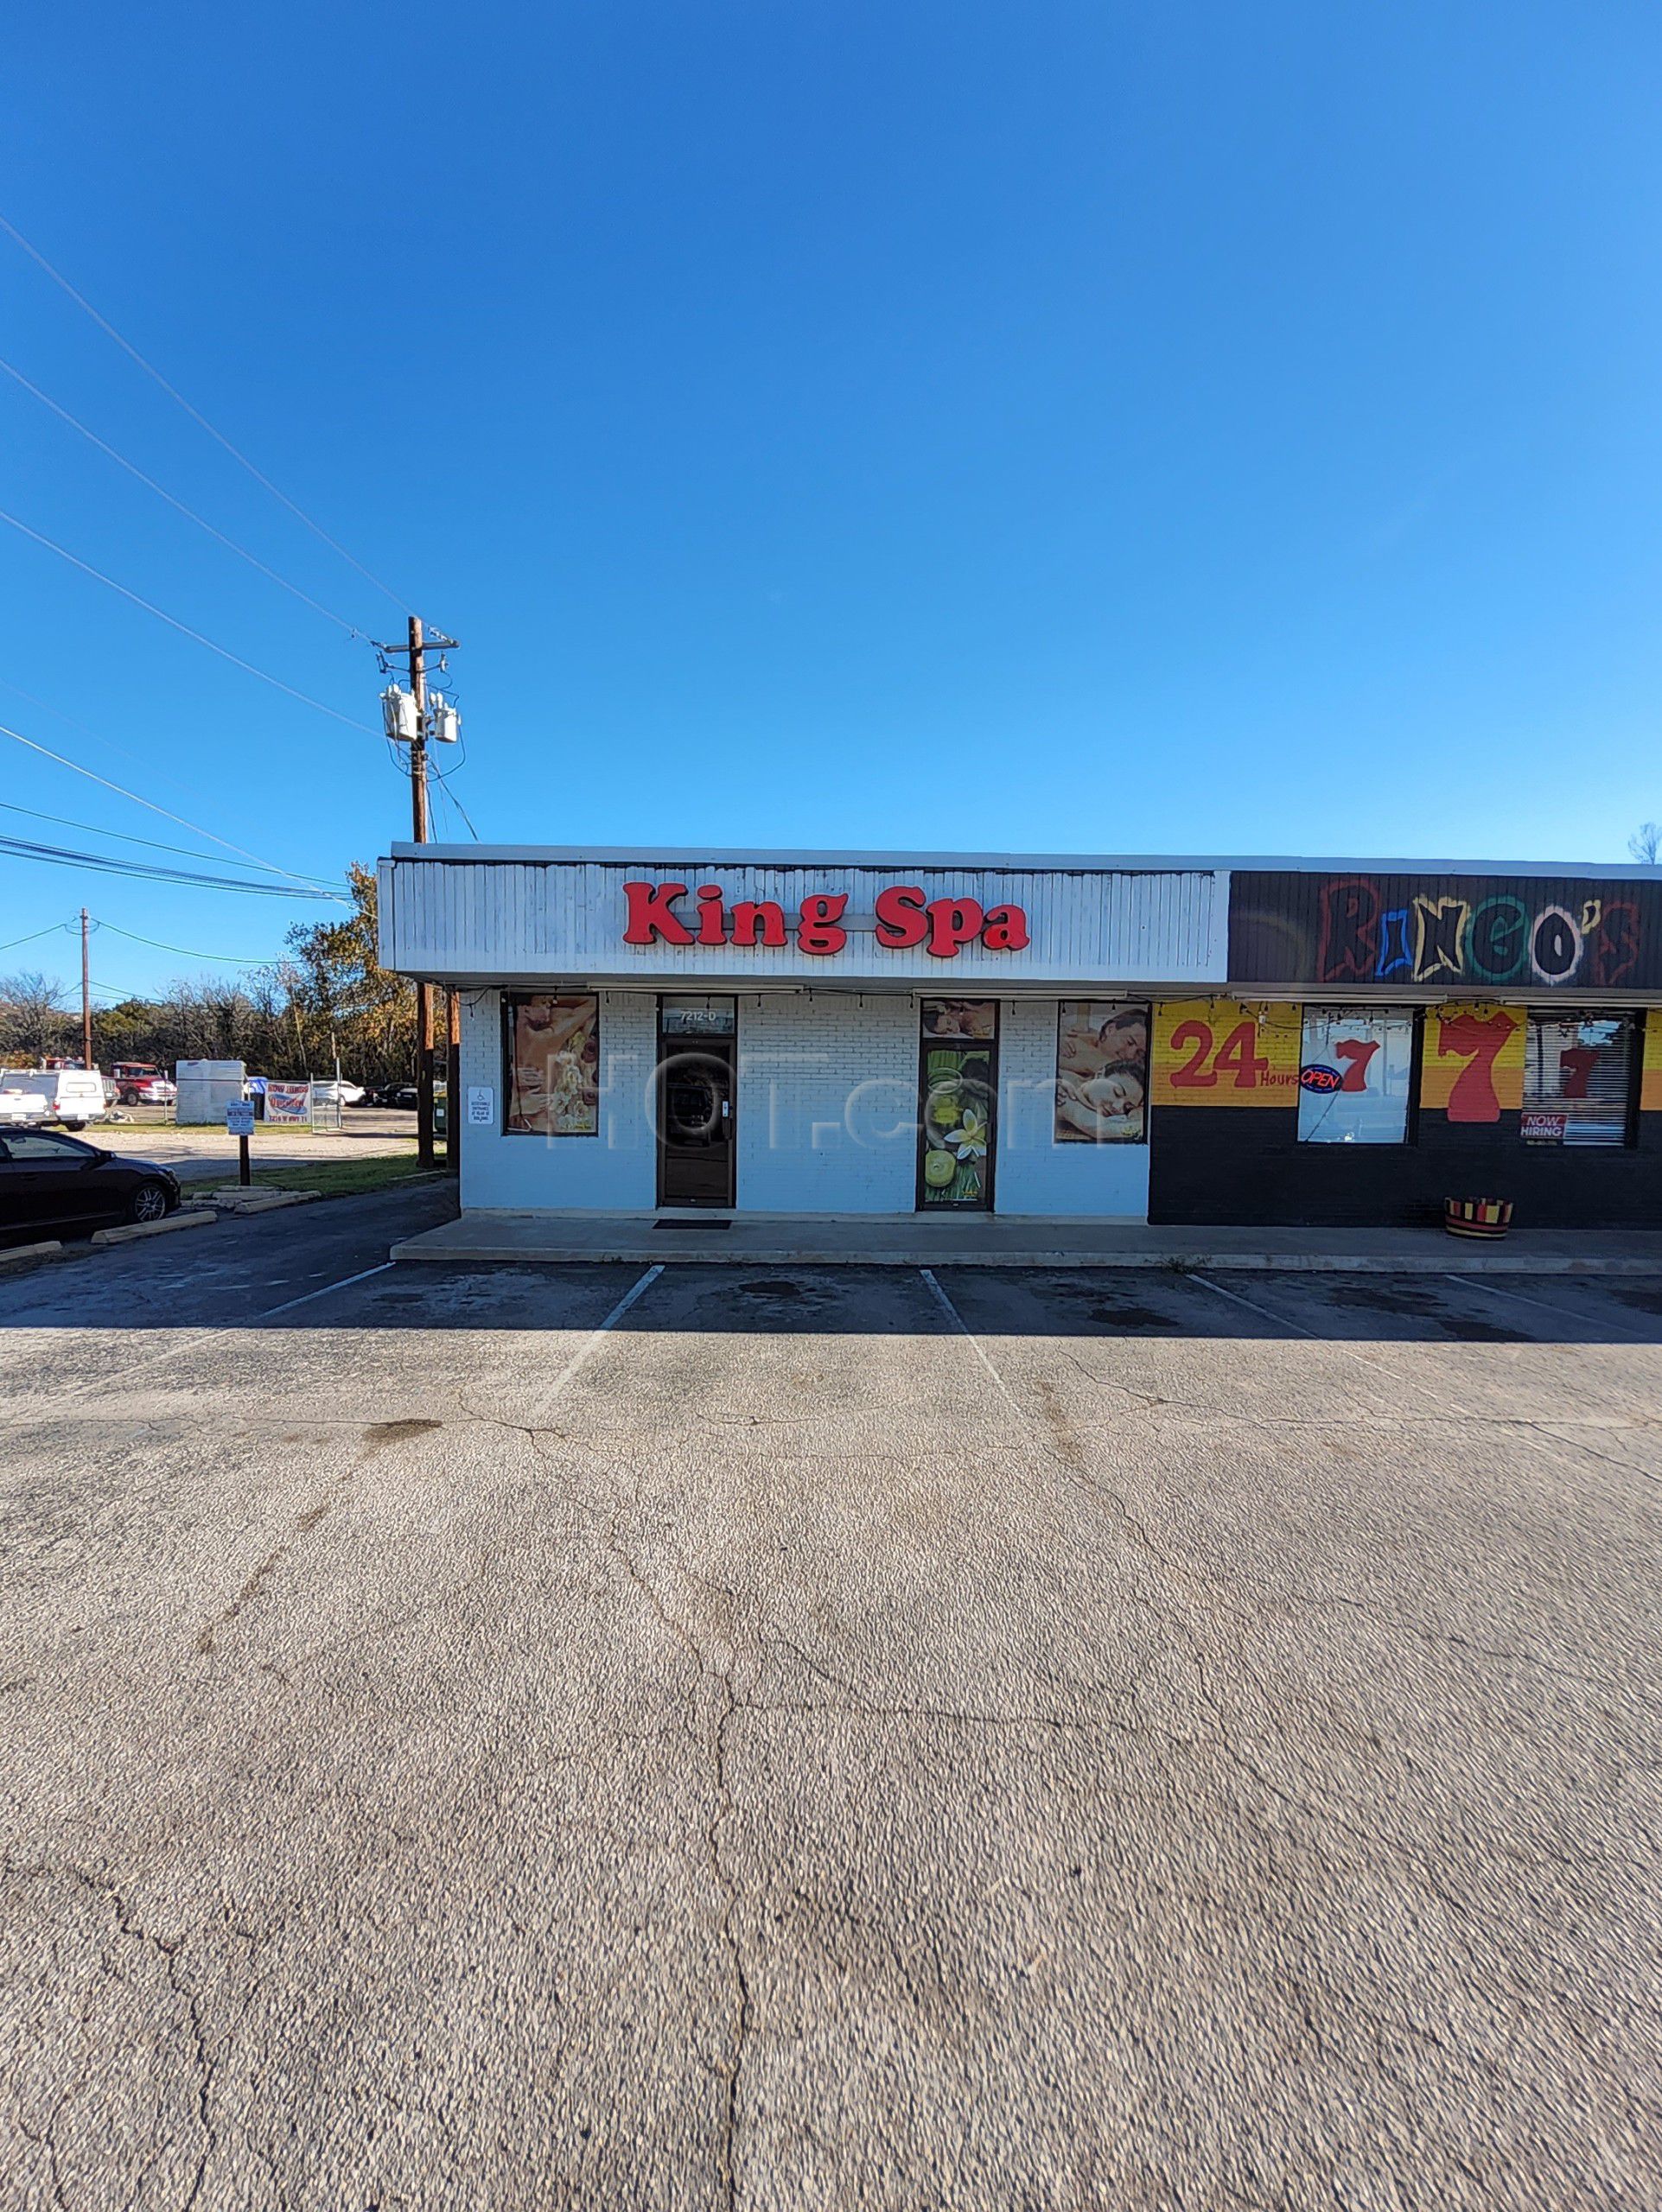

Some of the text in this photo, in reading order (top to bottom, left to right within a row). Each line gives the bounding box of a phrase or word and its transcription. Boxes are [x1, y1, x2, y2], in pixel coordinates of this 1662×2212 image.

[622, 881, 1031, 959] King Spa
[679, 1010, 716, 1021] 7212-D
[1169, 1019, 1300, 1089] 24 Hours
[1335, 1039, 1380, 1092] 7
[1437, 1010, 1519, 1123] 7
[1301, 1069, 1340, 1089] OPEN
[1520, 1126, 1563, 1137] HIRING
[1526, 1116, 1563, 1126] NOW
